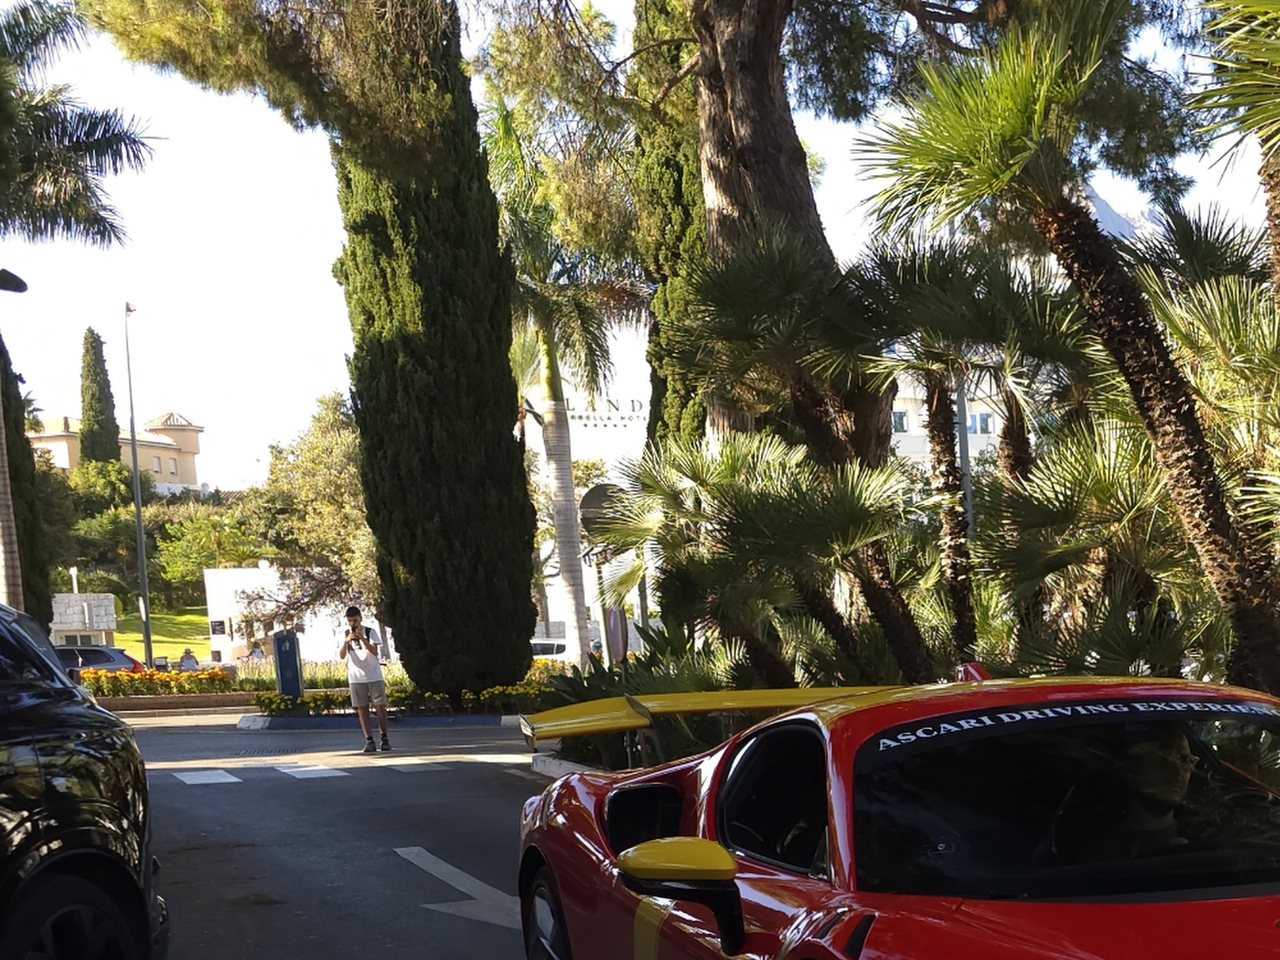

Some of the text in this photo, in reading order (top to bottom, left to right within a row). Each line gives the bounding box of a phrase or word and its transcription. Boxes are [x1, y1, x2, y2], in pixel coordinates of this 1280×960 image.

[565, 398, 643, 413] LAND
[878, 715, 996, 751] ASCARI
[997, 703, 1131, 724] DRIVING
